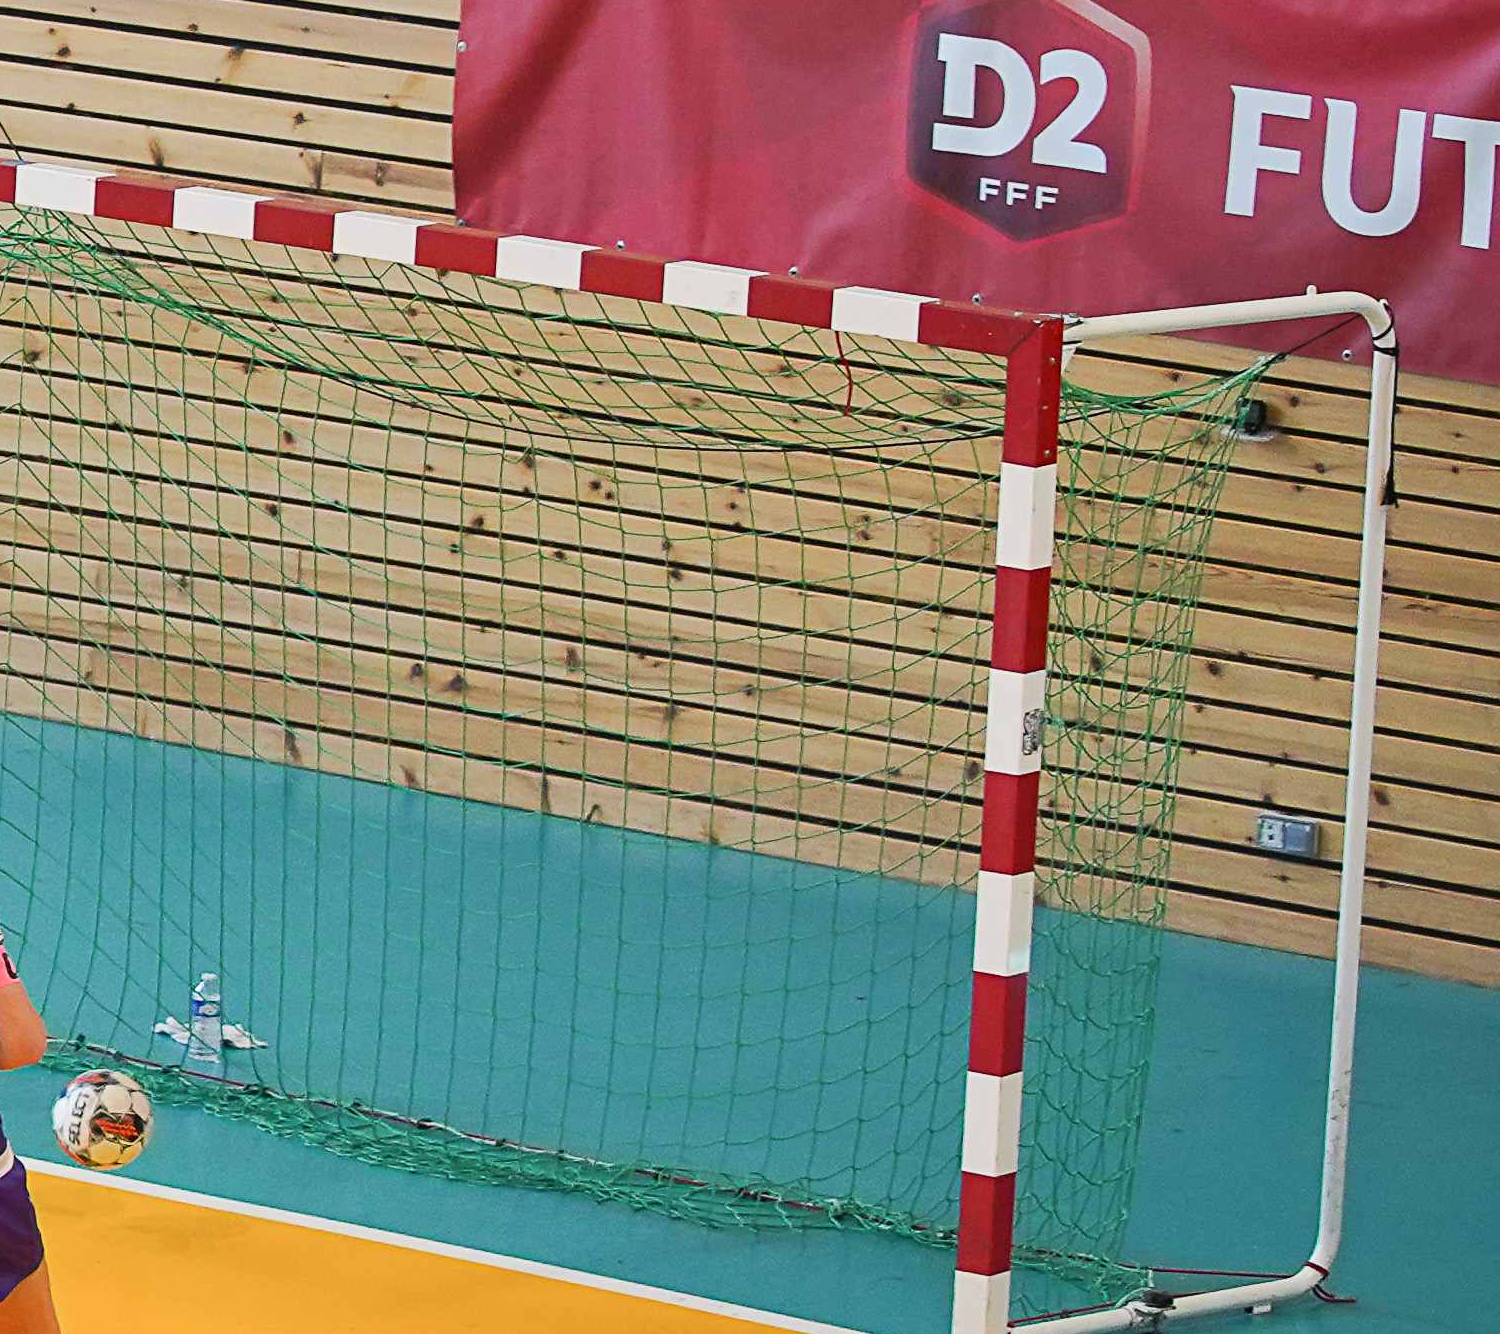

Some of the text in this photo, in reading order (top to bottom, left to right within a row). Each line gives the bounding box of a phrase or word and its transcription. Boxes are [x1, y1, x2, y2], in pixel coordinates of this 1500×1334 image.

[931, 32, 1108, 174] D2
[1223, 84, 1500, 250] FUT
[979, 177, 1060, 210] FFF
